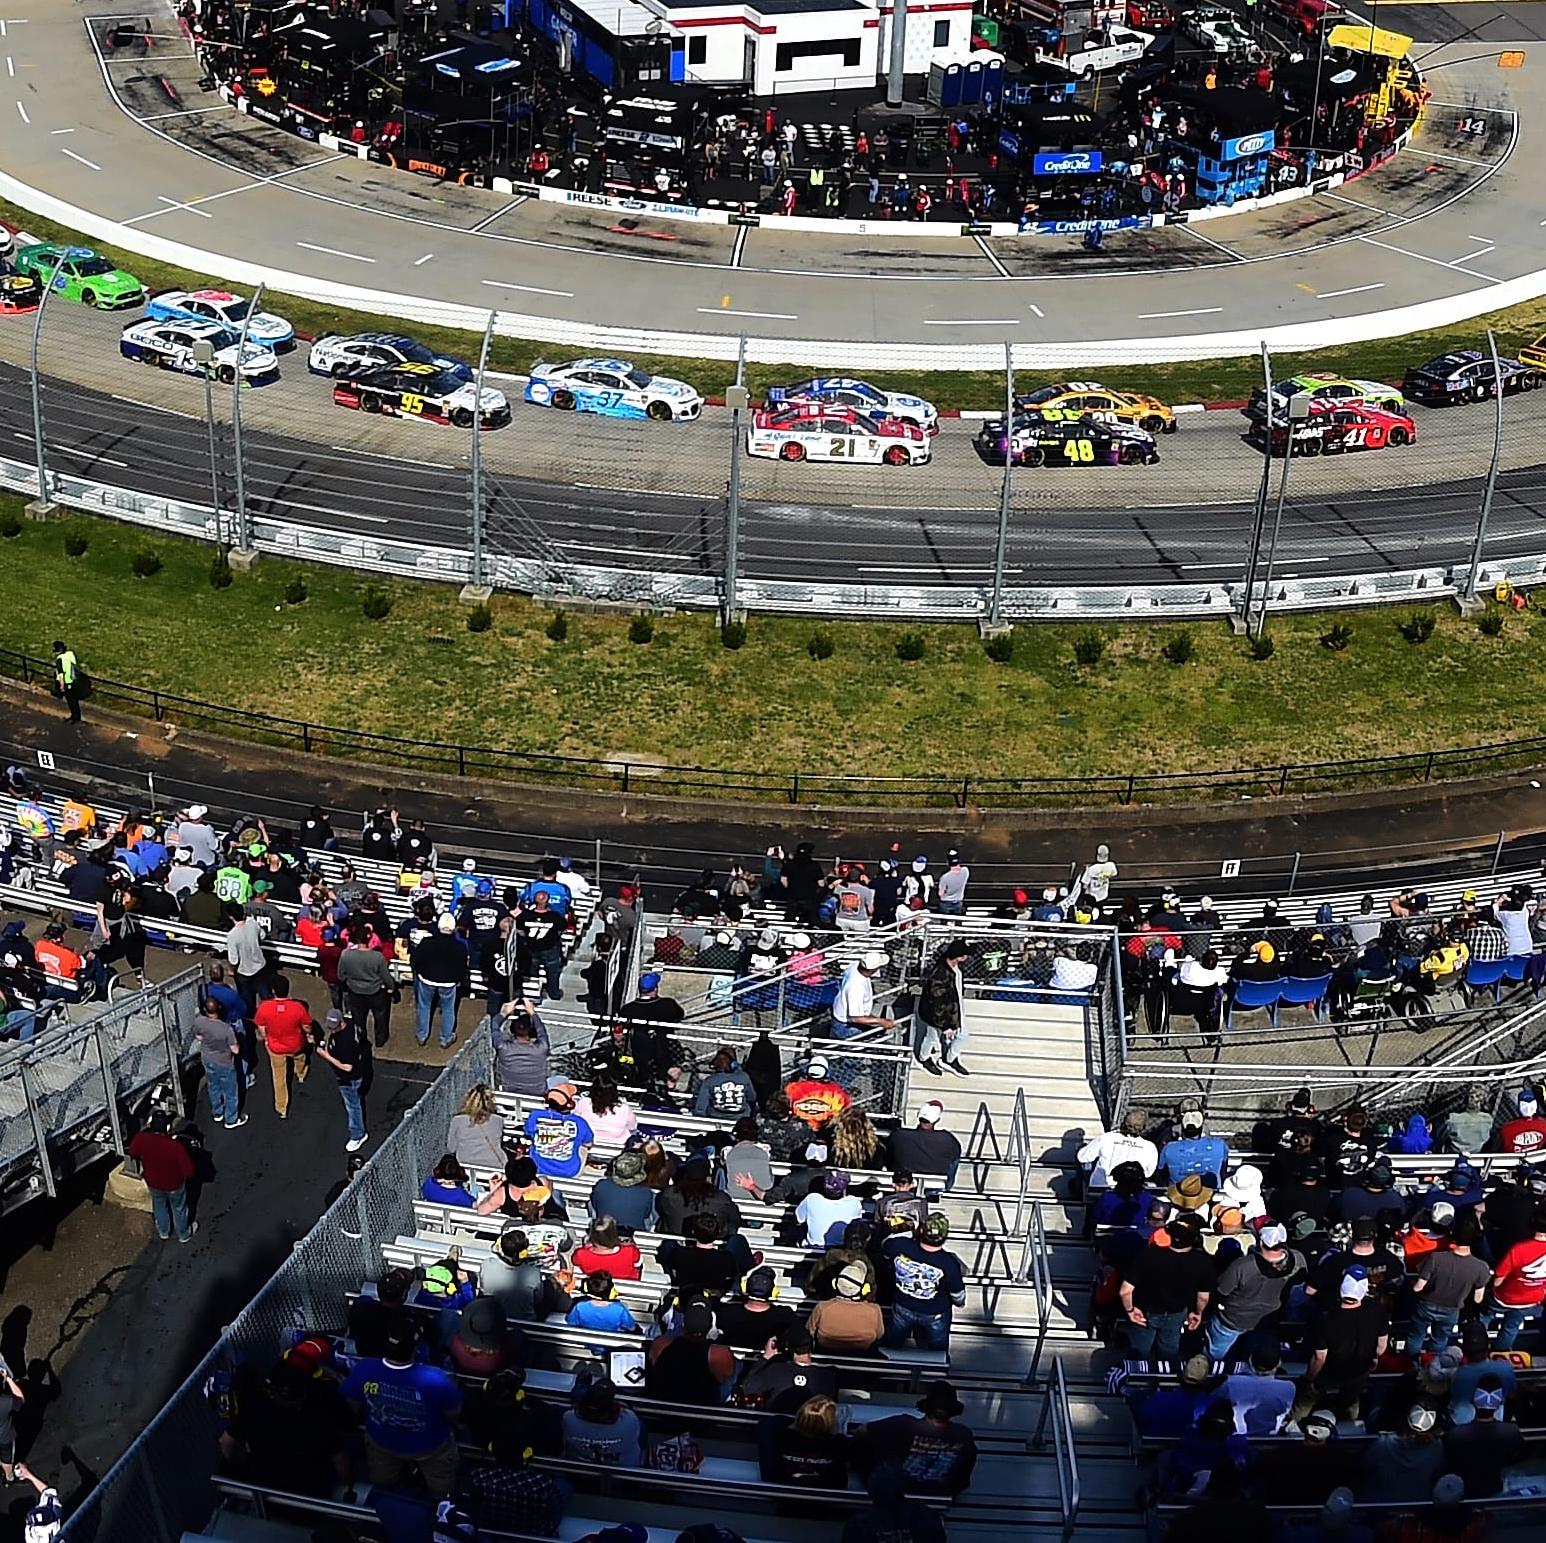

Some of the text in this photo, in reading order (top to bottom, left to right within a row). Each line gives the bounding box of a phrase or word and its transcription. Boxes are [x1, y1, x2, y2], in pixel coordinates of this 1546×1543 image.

[1461, 117, 1485, 135] 14
[1279, 165, 1299, 183] 43
[572, 191, 613, 206] REESE
[130, 333, 175, 351] GEICO
[174, 350, 198, 370] 13
[399, 393, 425, 414] 95
[596, 390, 625, 408] 37
[830, 437, 856, 457] 21
[1342, 427, 1368, 447] 41
[1063, 439, 1095, 462] 48
[220, 878, 240, 898] 88
